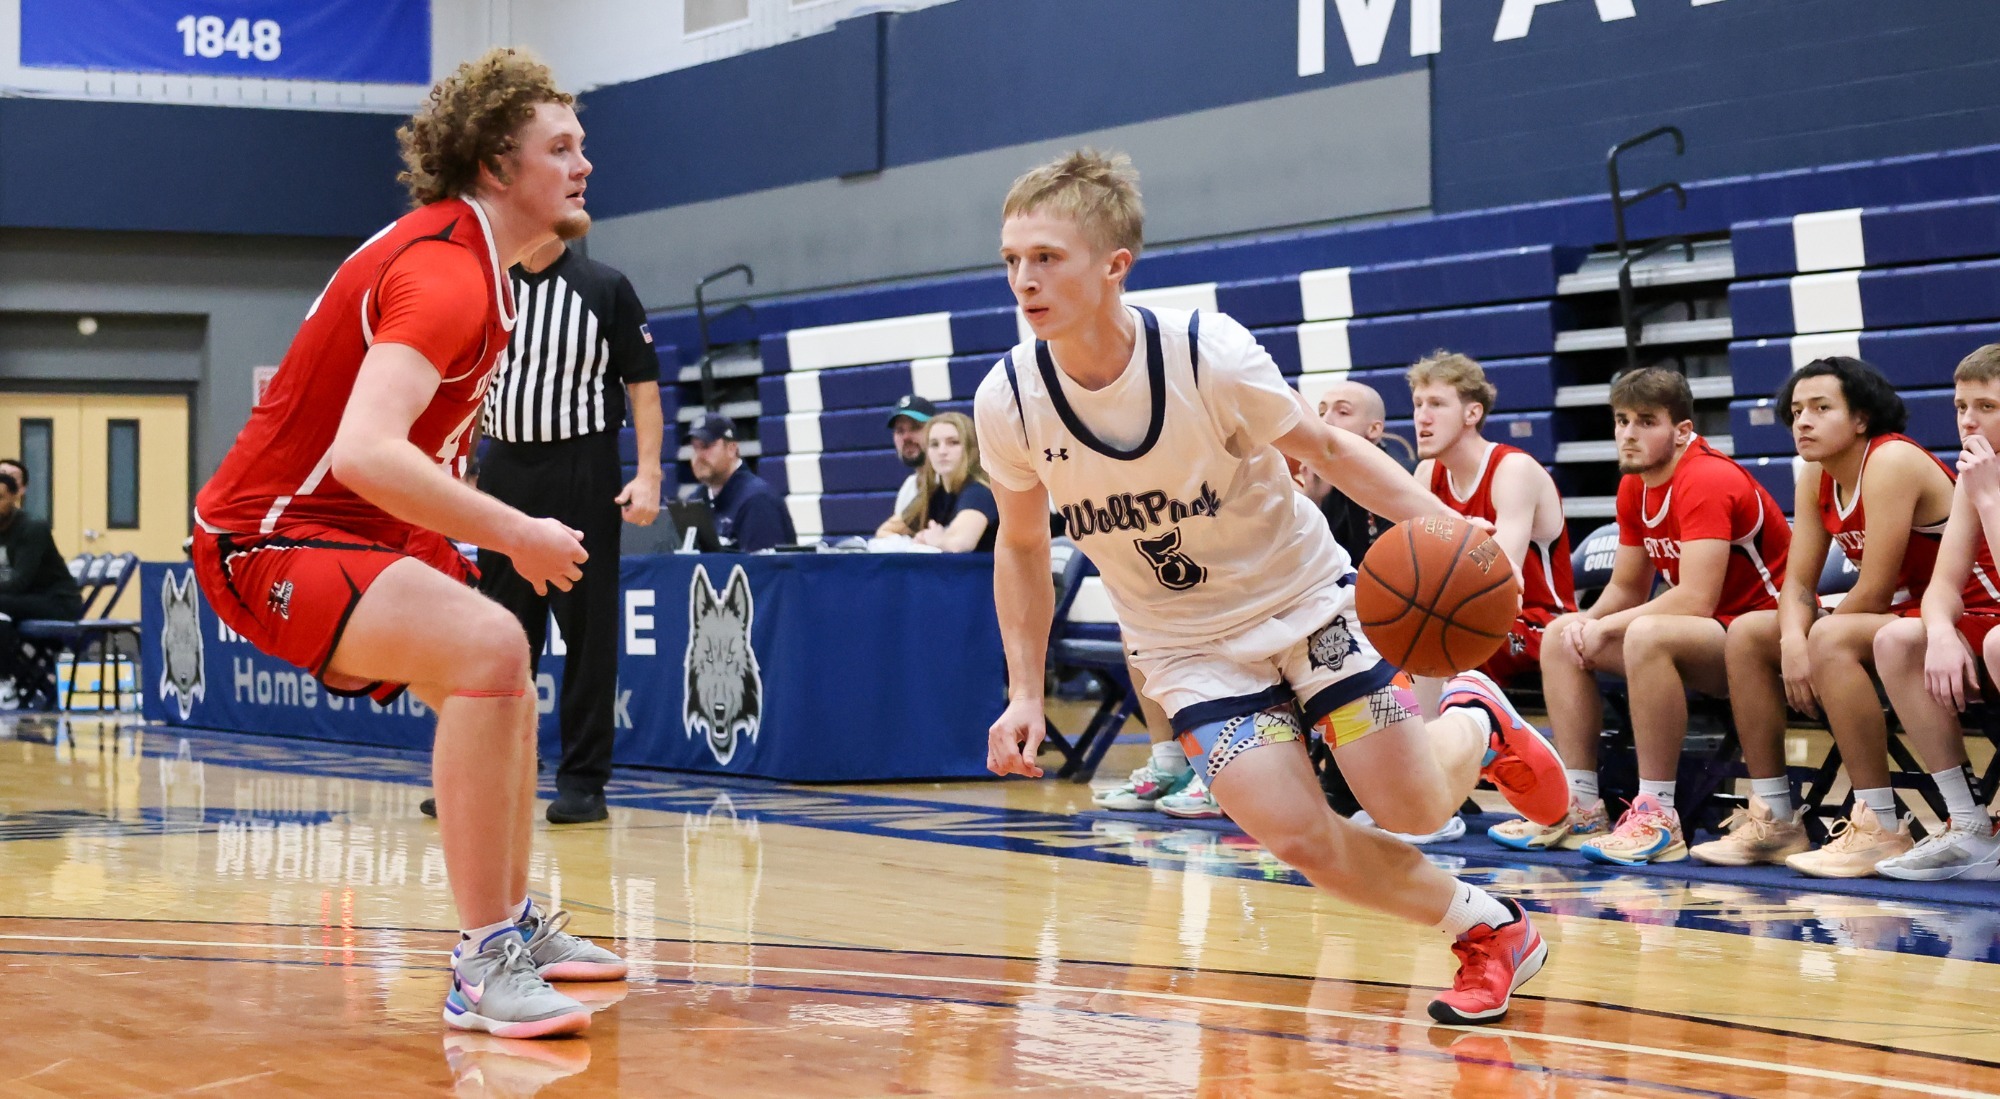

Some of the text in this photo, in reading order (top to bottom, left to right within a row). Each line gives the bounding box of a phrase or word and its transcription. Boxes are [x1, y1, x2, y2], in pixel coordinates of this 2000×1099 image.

[176, 14, 282, 61] 1848
[1133, 526, 1208, 591] 5
[234, 656, 318, 708] Home
